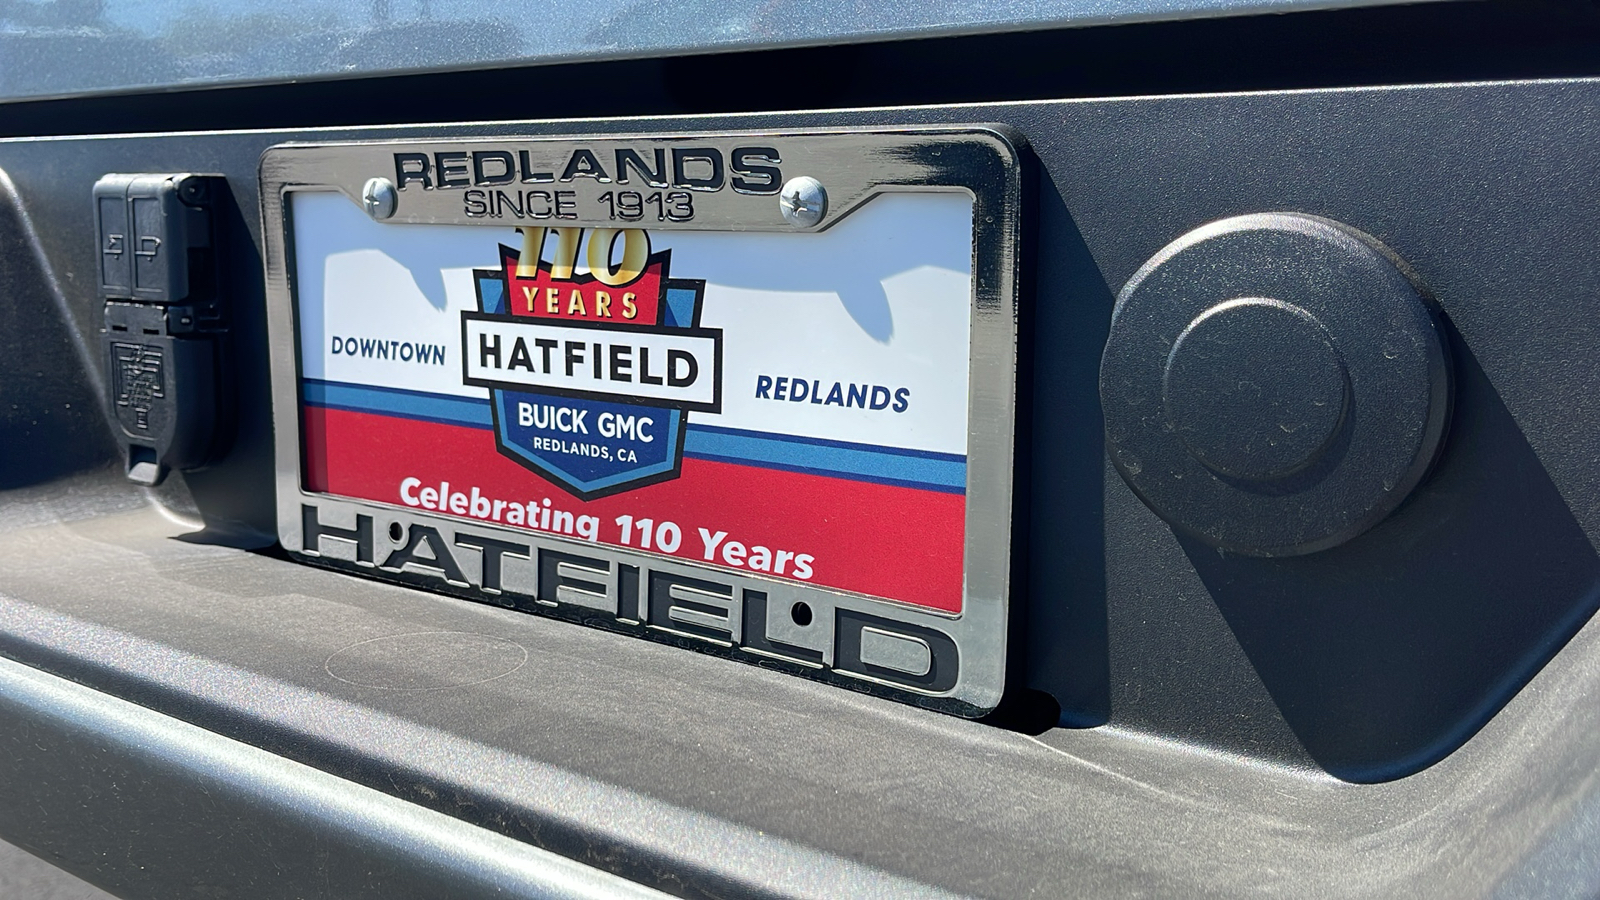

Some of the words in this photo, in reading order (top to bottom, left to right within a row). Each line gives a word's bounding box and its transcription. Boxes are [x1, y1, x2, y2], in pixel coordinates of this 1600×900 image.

[393, 147, 783, 195] REDLANDS
[464, 190, 578, 220] SINCE
[598, 190, 694, 221] 1913
[515, 227, 652, 288] 110
[522, 287, 637, 319] YEARS
[331, 336, 446, 366] DOWNTOWN
[479, 333, 699, 388] HATFIELD
[755, 375, 910, 413] REDLANDS
[518, 402, 588, 435] BUICK
[597, 412, 654, 443] GMC
[533, 436, 614, 462] REDLANDS,
[617, 448, 638, 463] CA
[400, 477, 600, 542] Celebrating
[615, 514, 682, 553] 110
[698, 527, 815, 579] Years
[302, 503, 960, 695] HATFIELD
